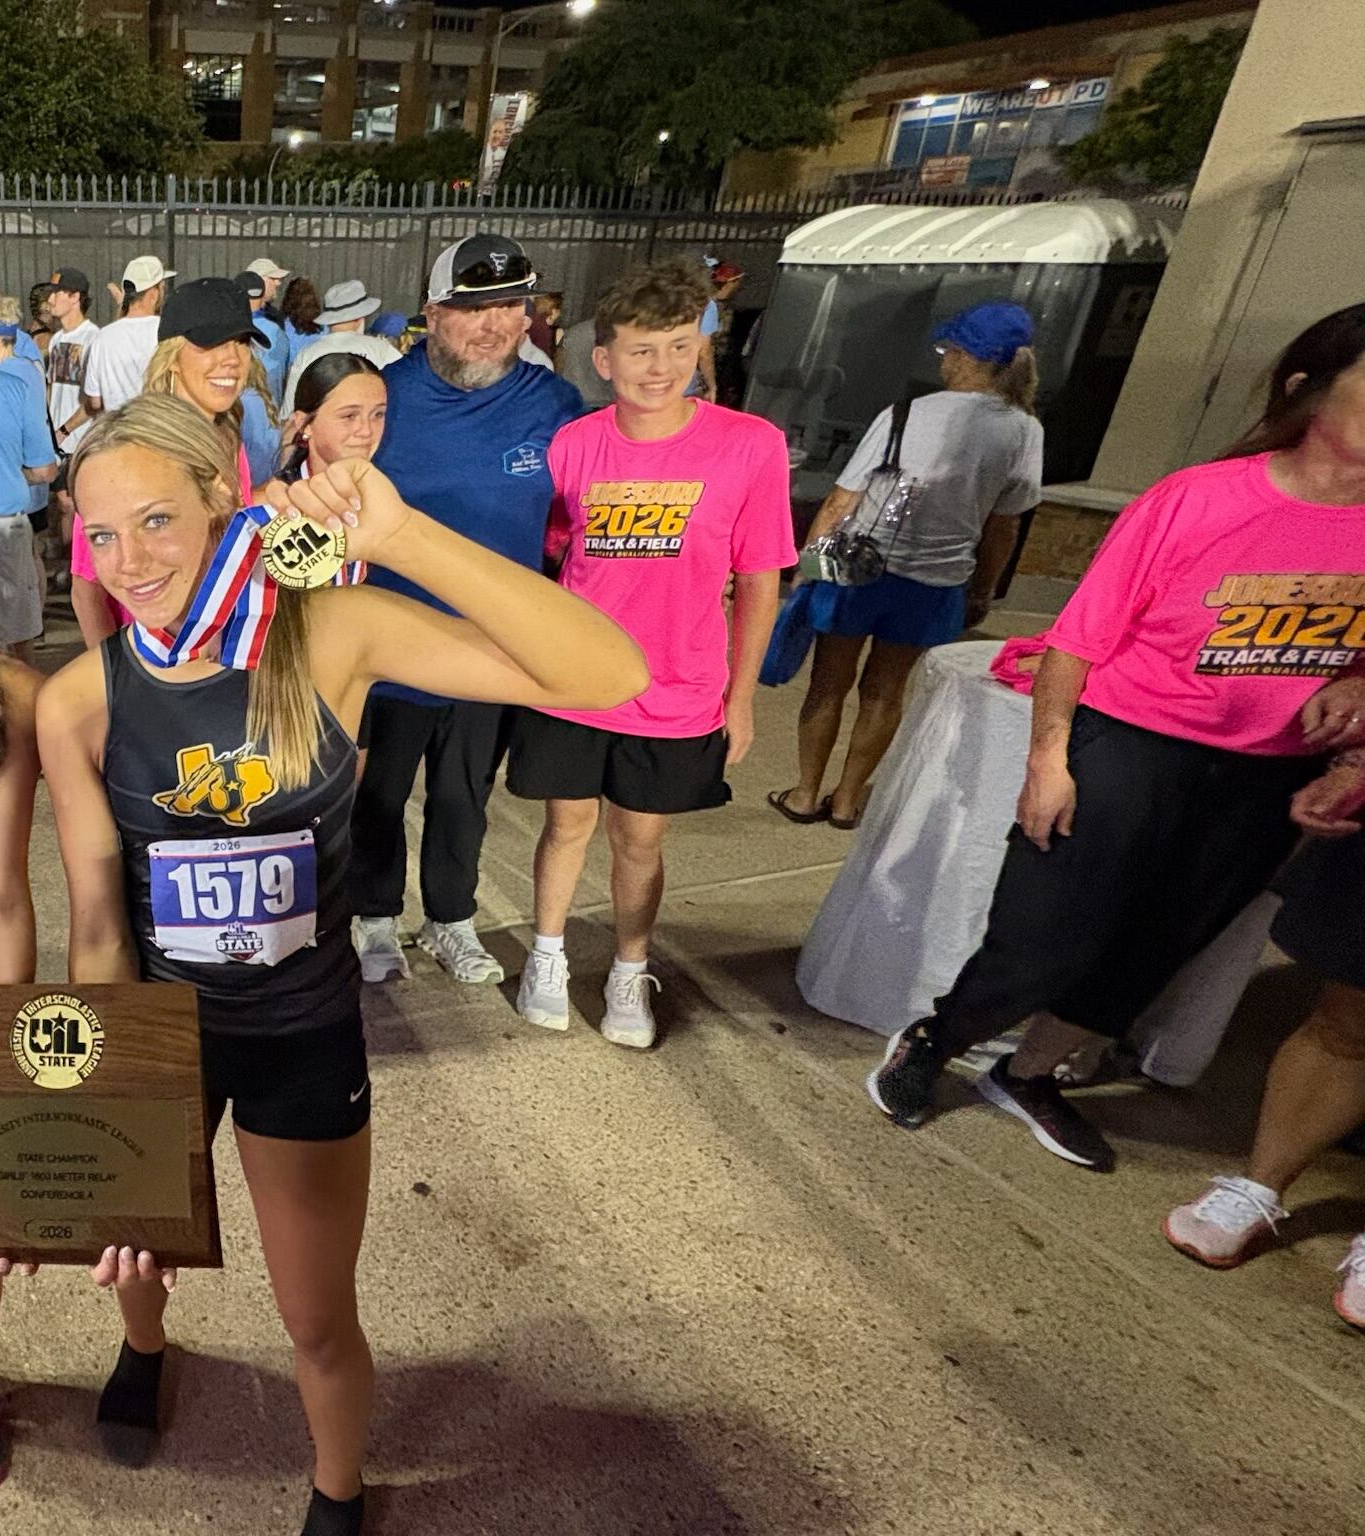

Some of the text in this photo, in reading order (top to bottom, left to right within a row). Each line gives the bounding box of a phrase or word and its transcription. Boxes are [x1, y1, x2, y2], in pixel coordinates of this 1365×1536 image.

[585, 504, 693, 537] 2026
[299, 549, 330, 574] STATE
[213, 841, 241, 851] 2026
[168, 855, 294, 920] 1579
[216, 938, 263, 950] STATE
[12, 995, 104, 1079] UNIVERSITY INTERSCHOLASTIC LEAGUE
[39, 1056, 76, 1067] STATE
[23, 1112, 111, 1133] INTERSCHOLASTIC
[110, 1128, 146, 1159] LEAGUE
[17, 1153, 99, 1164] STATE CHAMPION
[53, 1172, 86, 1182] METER
[88, 1172, 118, 1182] RELAY
[20, 1189, 84, 1200] CONFERENCE
[39, 1225, 73, 1239] 2026
